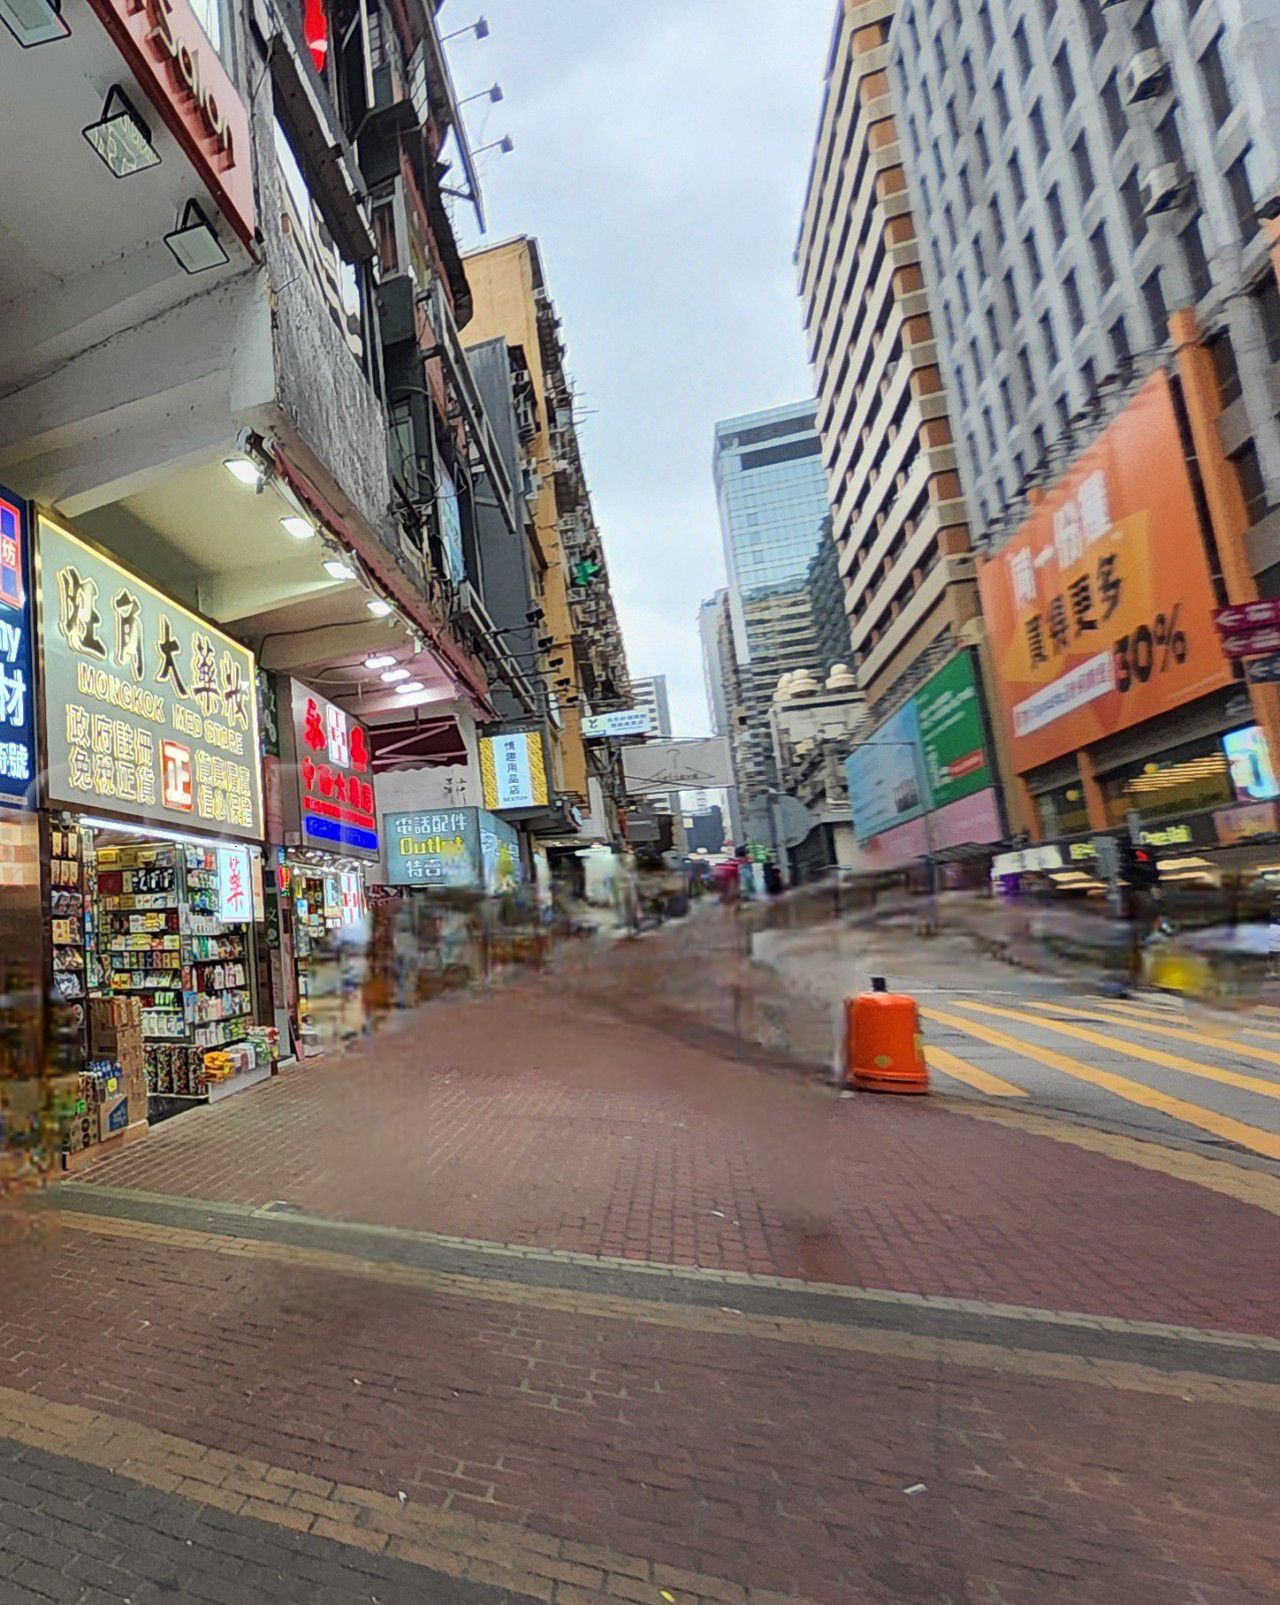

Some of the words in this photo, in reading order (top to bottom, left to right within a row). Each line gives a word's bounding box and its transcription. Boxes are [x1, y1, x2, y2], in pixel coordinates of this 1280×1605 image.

[77, 661, 166, 724] MONGKOK
[172, 703, 203, 739] MED
[204, 718, 244, 757] STORE
[163, 742, 192, 806] 正
